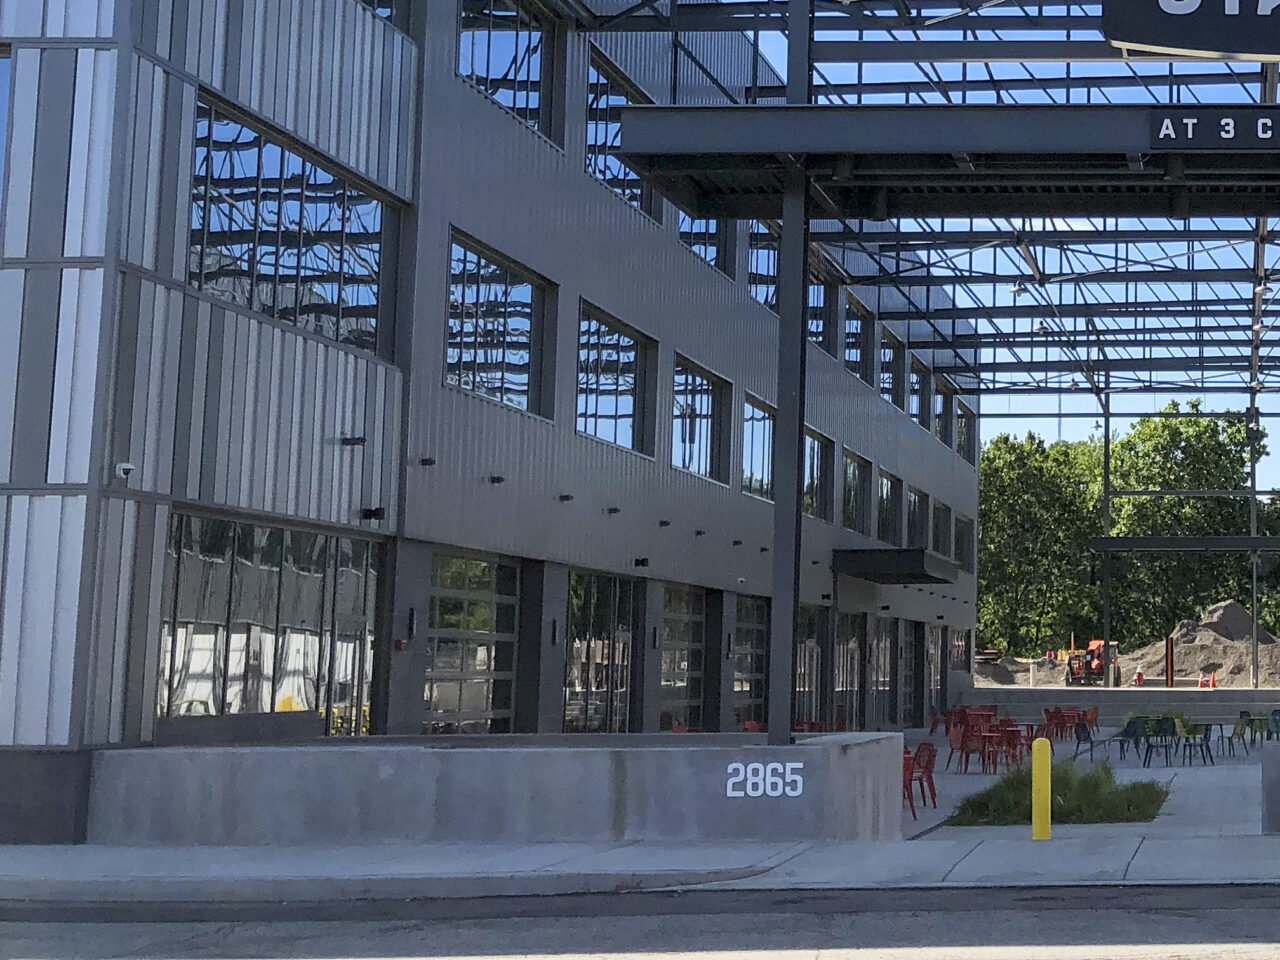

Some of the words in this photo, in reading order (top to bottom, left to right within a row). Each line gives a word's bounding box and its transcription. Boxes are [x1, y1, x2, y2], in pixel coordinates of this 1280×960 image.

[1158, 118, 1198, 139] AT
[1220, 118, 1235, 139] 3
[726, 762, 804, 797] 2865
